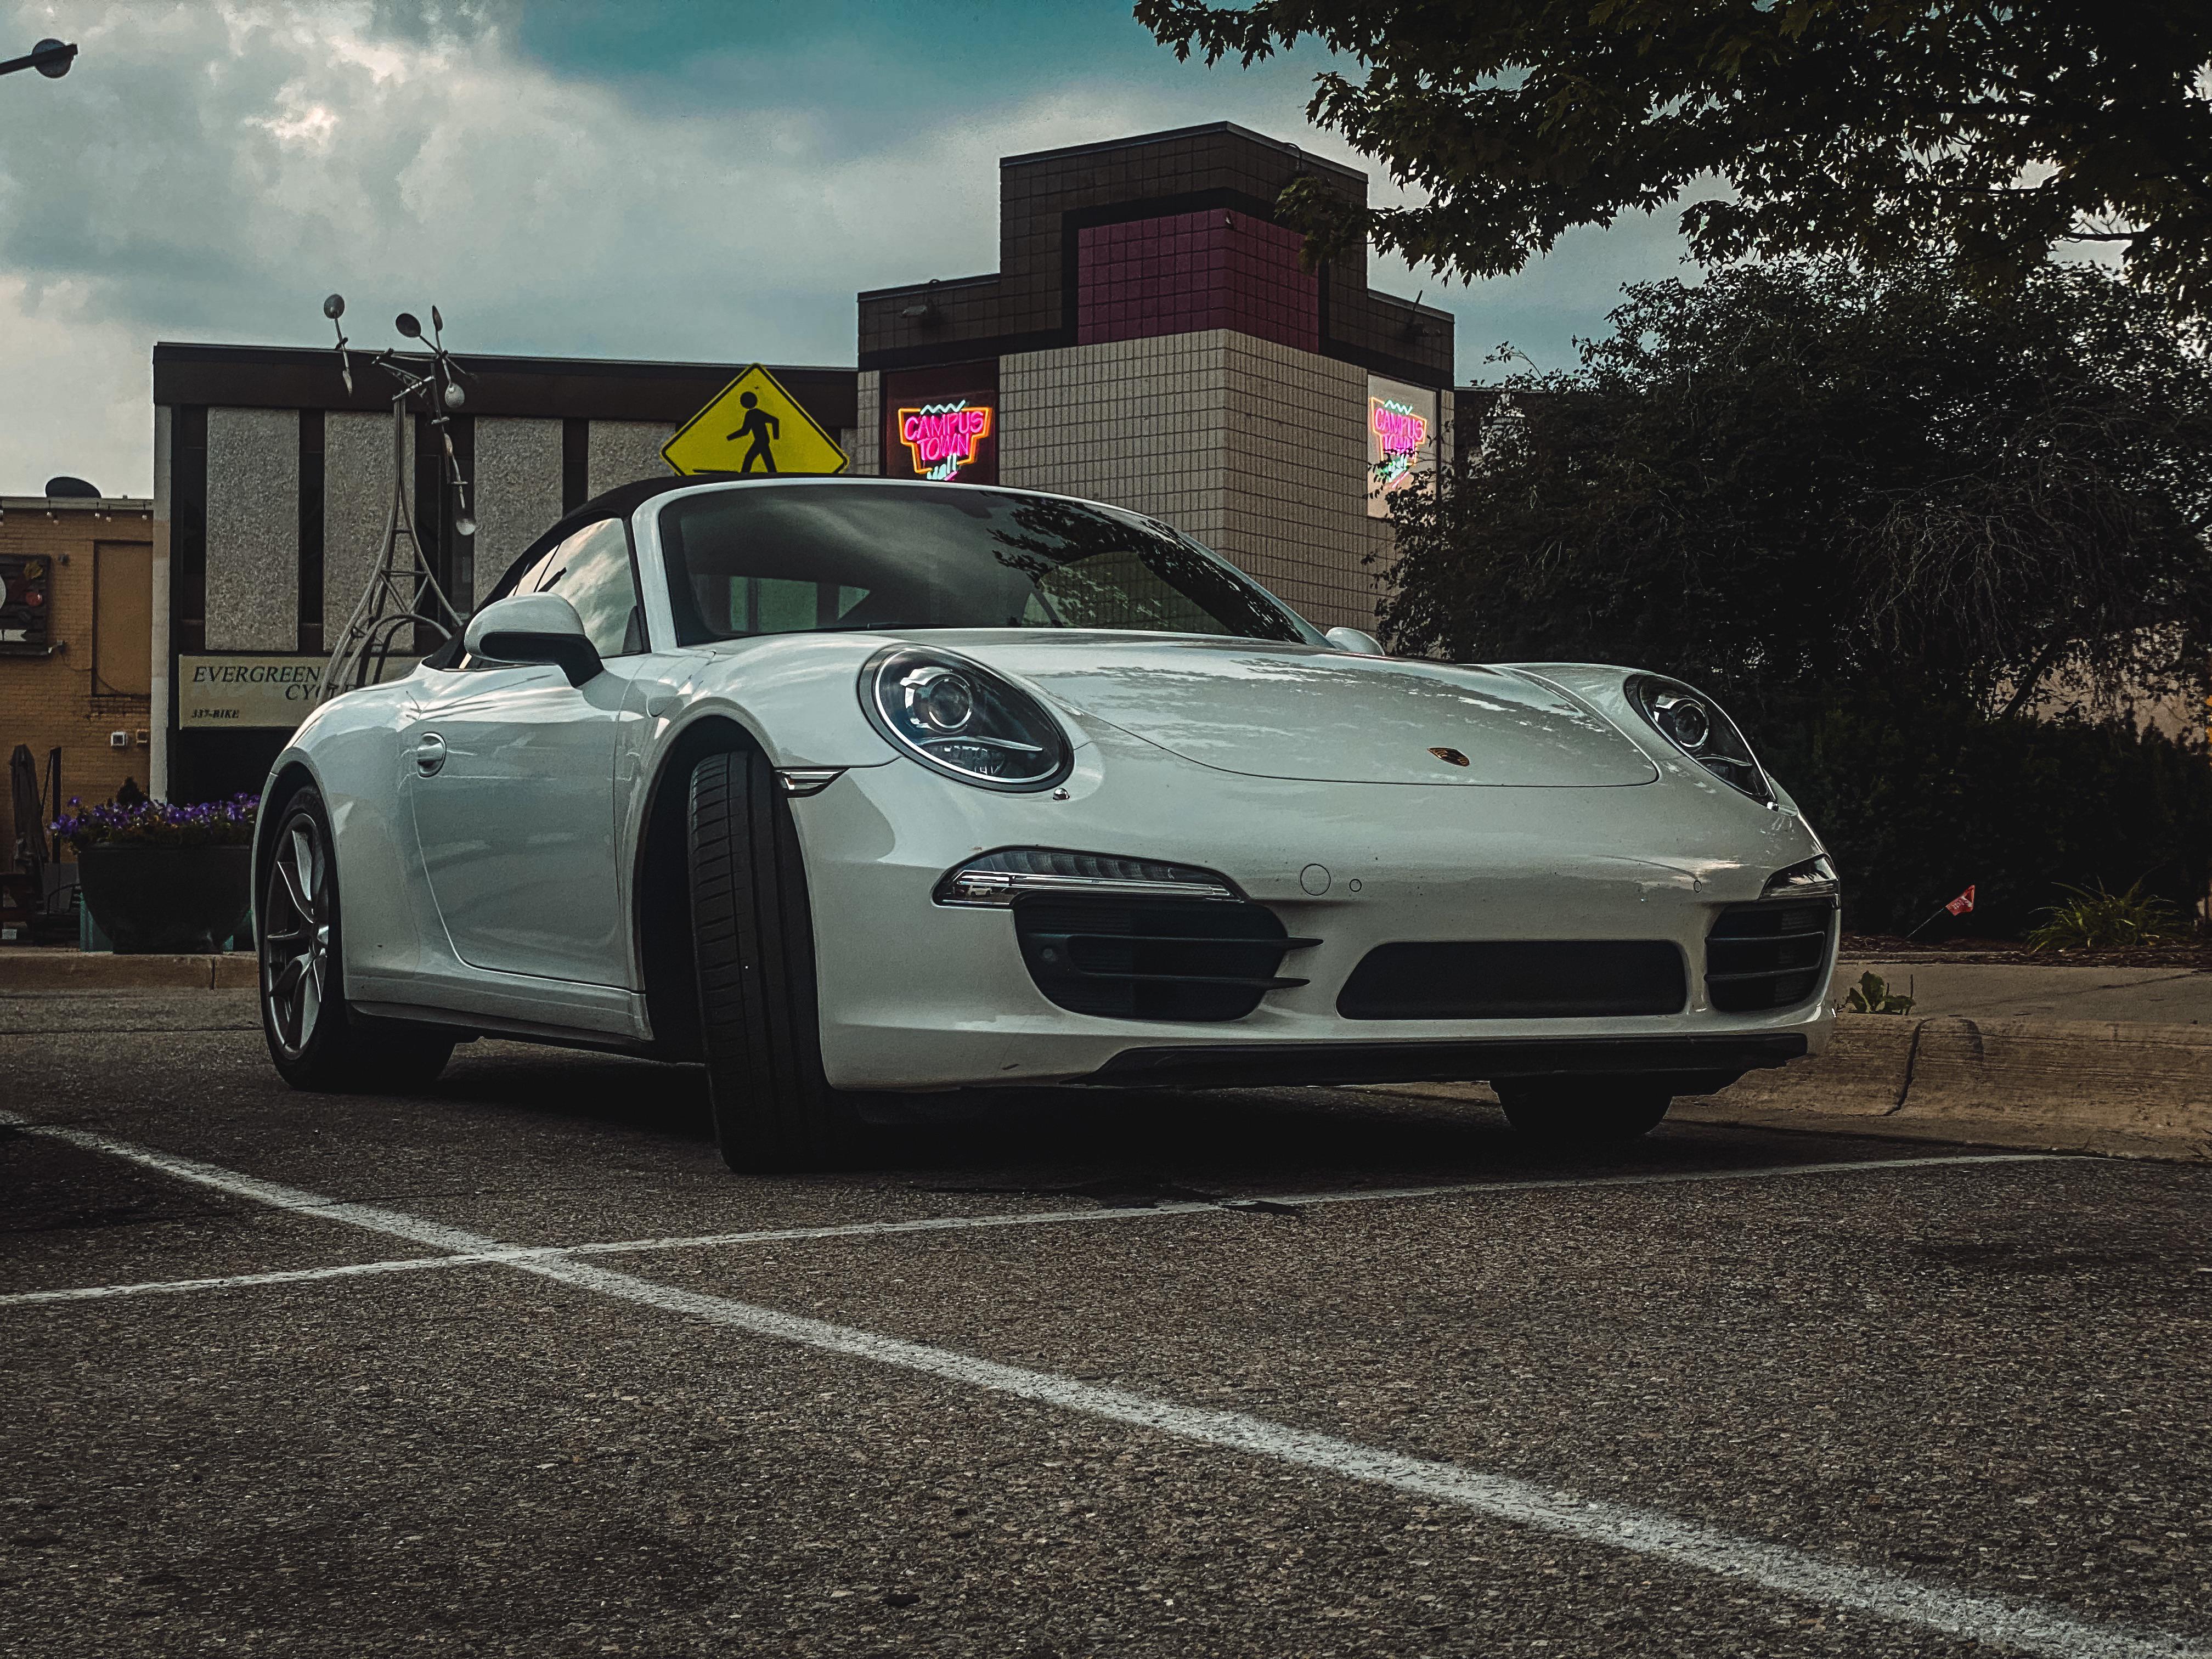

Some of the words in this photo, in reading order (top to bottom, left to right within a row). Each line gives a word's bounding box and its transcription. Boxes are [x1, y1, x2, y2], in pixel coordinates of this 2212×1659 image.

[905, 411, 984, 440] CAMPUS
[1375, 408, 1423, 441] CAMPUS
[917, 433, 969, 460] TOWN
[193, 666, 320, 682] EVERGREEN
